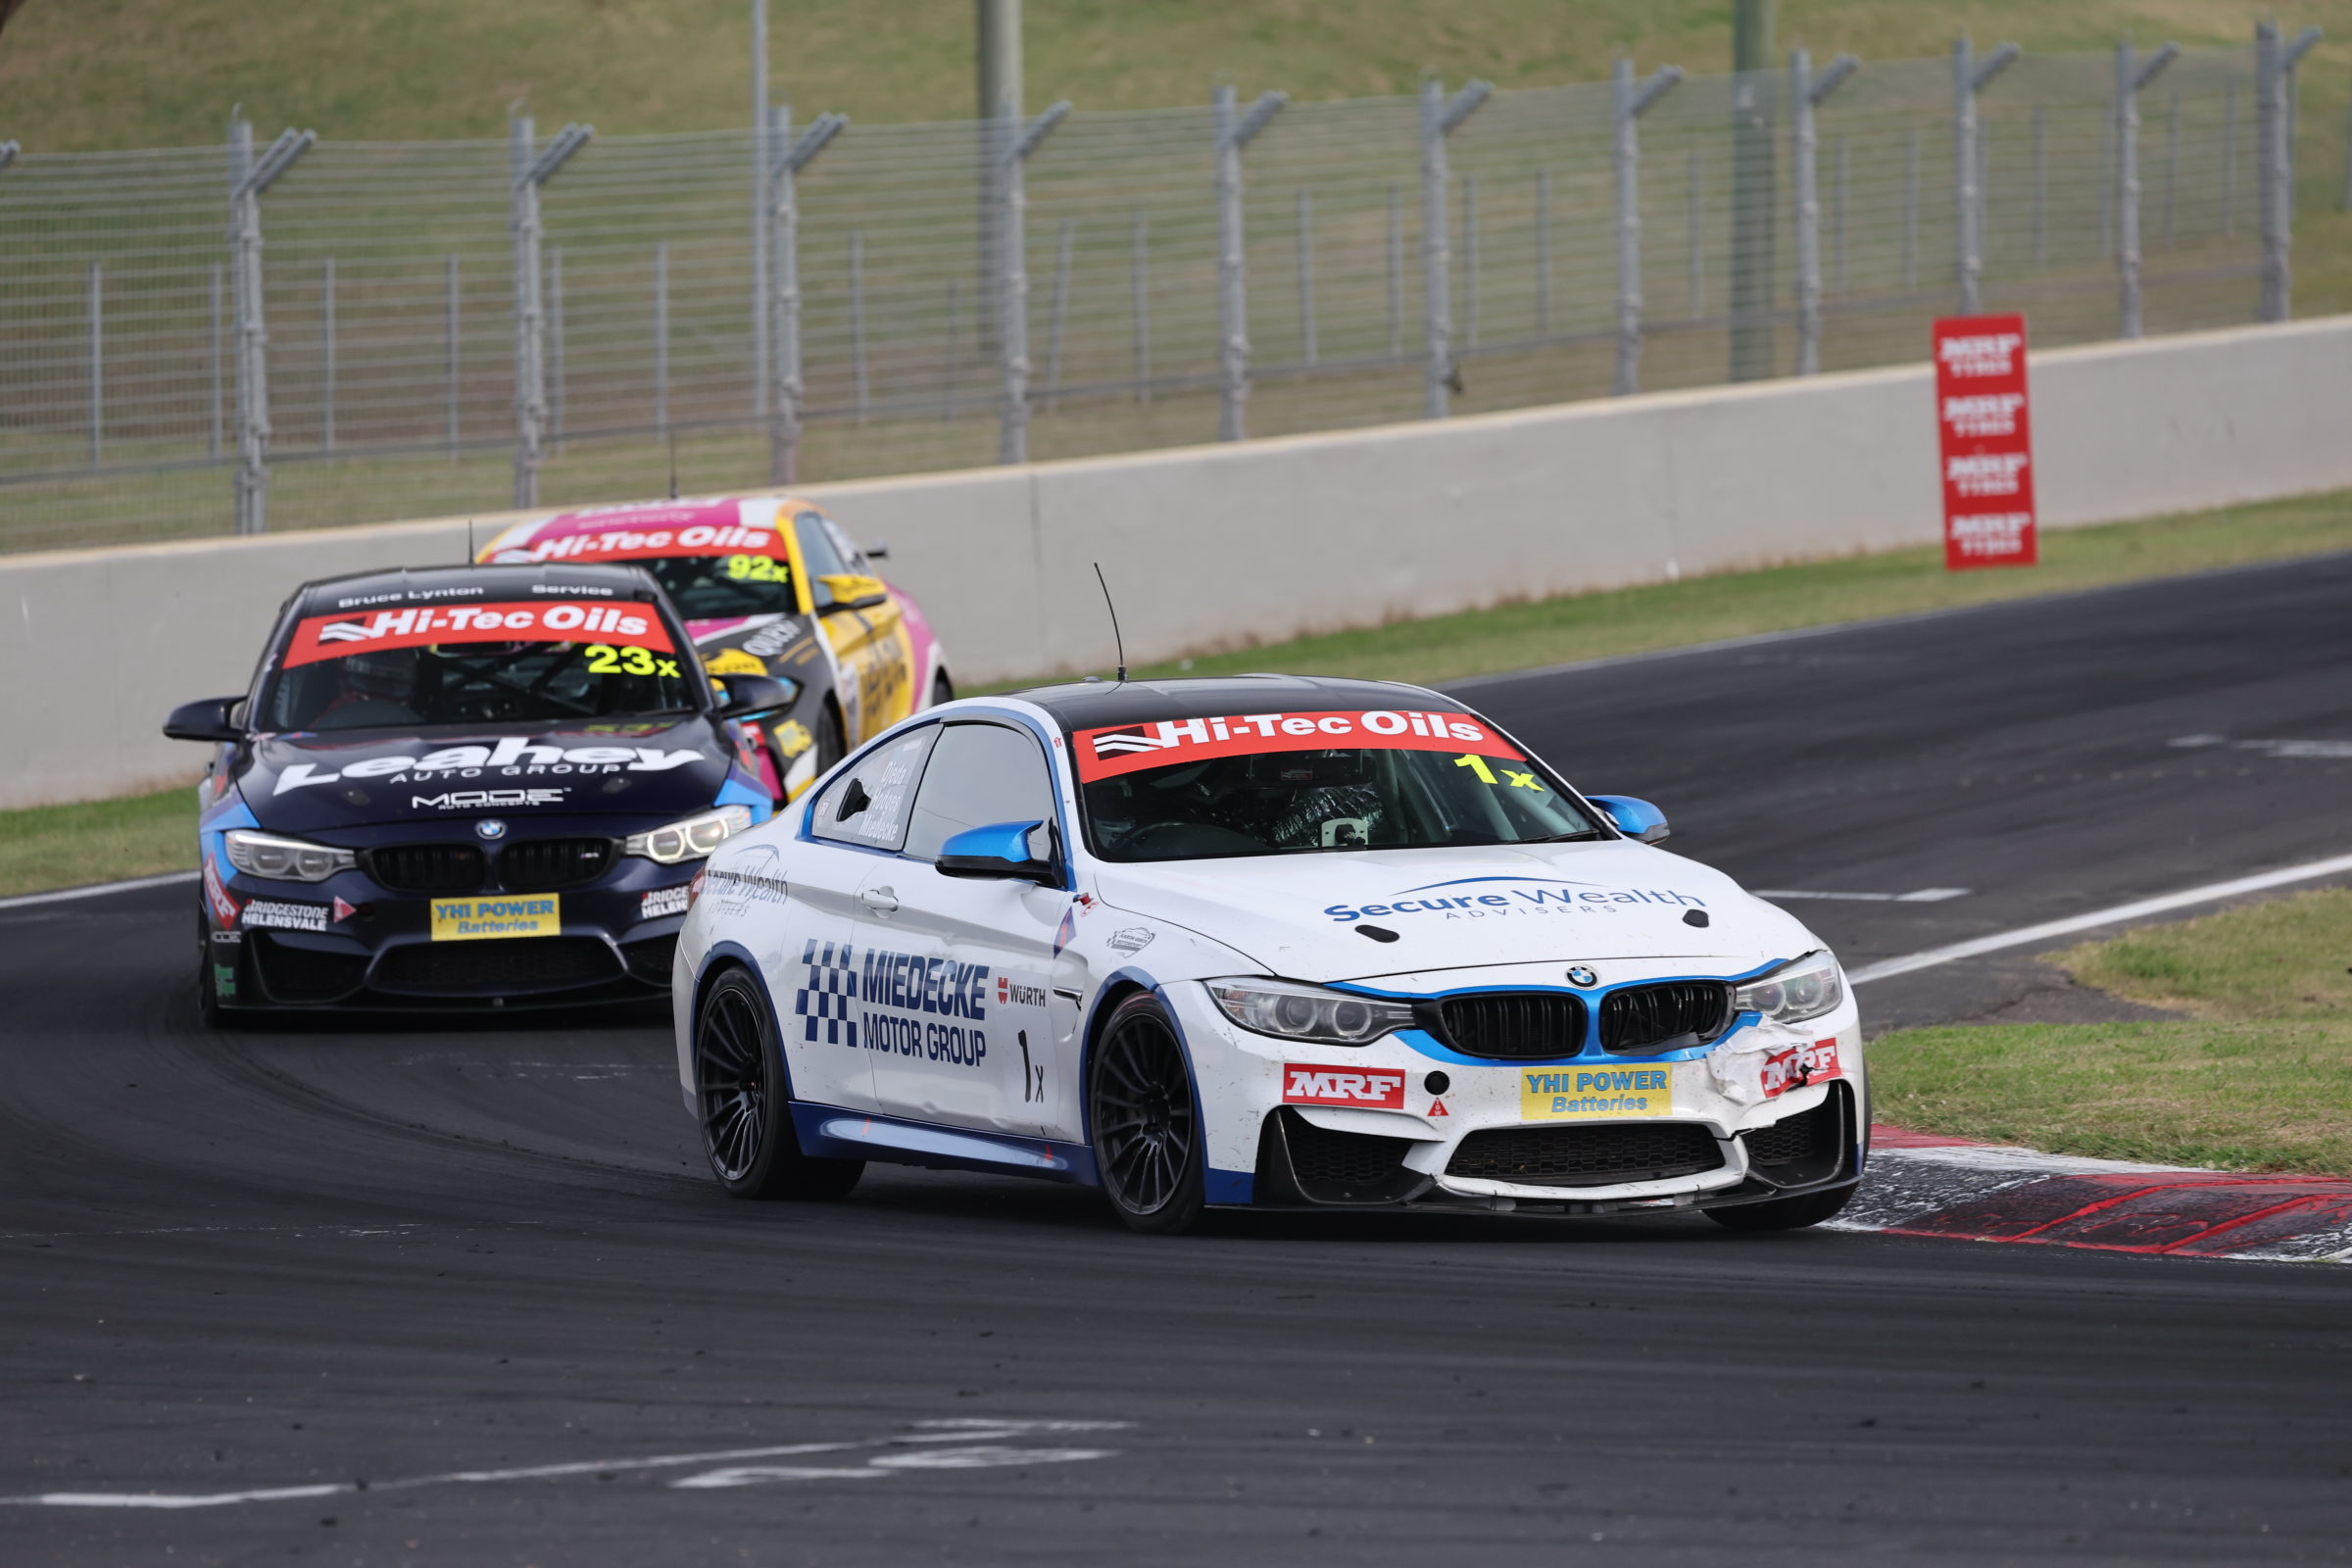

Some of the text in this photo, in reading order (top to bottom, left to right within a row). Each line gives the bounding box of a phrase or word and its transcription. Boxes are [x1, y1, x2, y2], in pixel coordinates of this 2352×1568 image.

[1940, 333, 2022, 363] MRF
[1943, 393, 2025, 421] MRF
[1947, 452, 2028, 481] MRF
[1950, 512, 2032, 539] MRF
[531, 525, 771, 561] Hi-Tec Oils
[728, 555, 788, 583] 92x
[338, 584, 613, 609] Bruce Lynton Service
[370, 605, 648, 639] Hi-Tec Oils
[584, 644, 681, 679] 23x
[1156, 710, 1485, 749] Hi-Tec Oils
[272, 737, 706, 796] Leahey
[389, 763, 621, 784] AUTO GROUP
[1453, 753, 1545, 792] 1x
[412, 788, 564, 808] MODE
[245, 899, 329, 919] BRIDGESTONE
[435, 900, 555, 919] YHI POWER
[641, 886, 690, 906] BRIDGE
[641, 900, 688, 918] HELEN
[1323, 889, 1708, 922] Secure Wealth
[241, 913, 327, 931] HELENSVALE
[458, 918, 539, 935] Batteries
[1446, 905, 1617, 920] ADVISERS
[862, 948, 990, 1021] MIEDECKE
[863, 1011, 986, 1066] MOTOR GROUP
[1525, 1070, 1668, 1094] YHI POWER
[1764, 1046, 1837, 1091] MRF
[1286, 1070, 1402, 1101] MRF
[1551, 1094, 1648, 1114] Batteries
